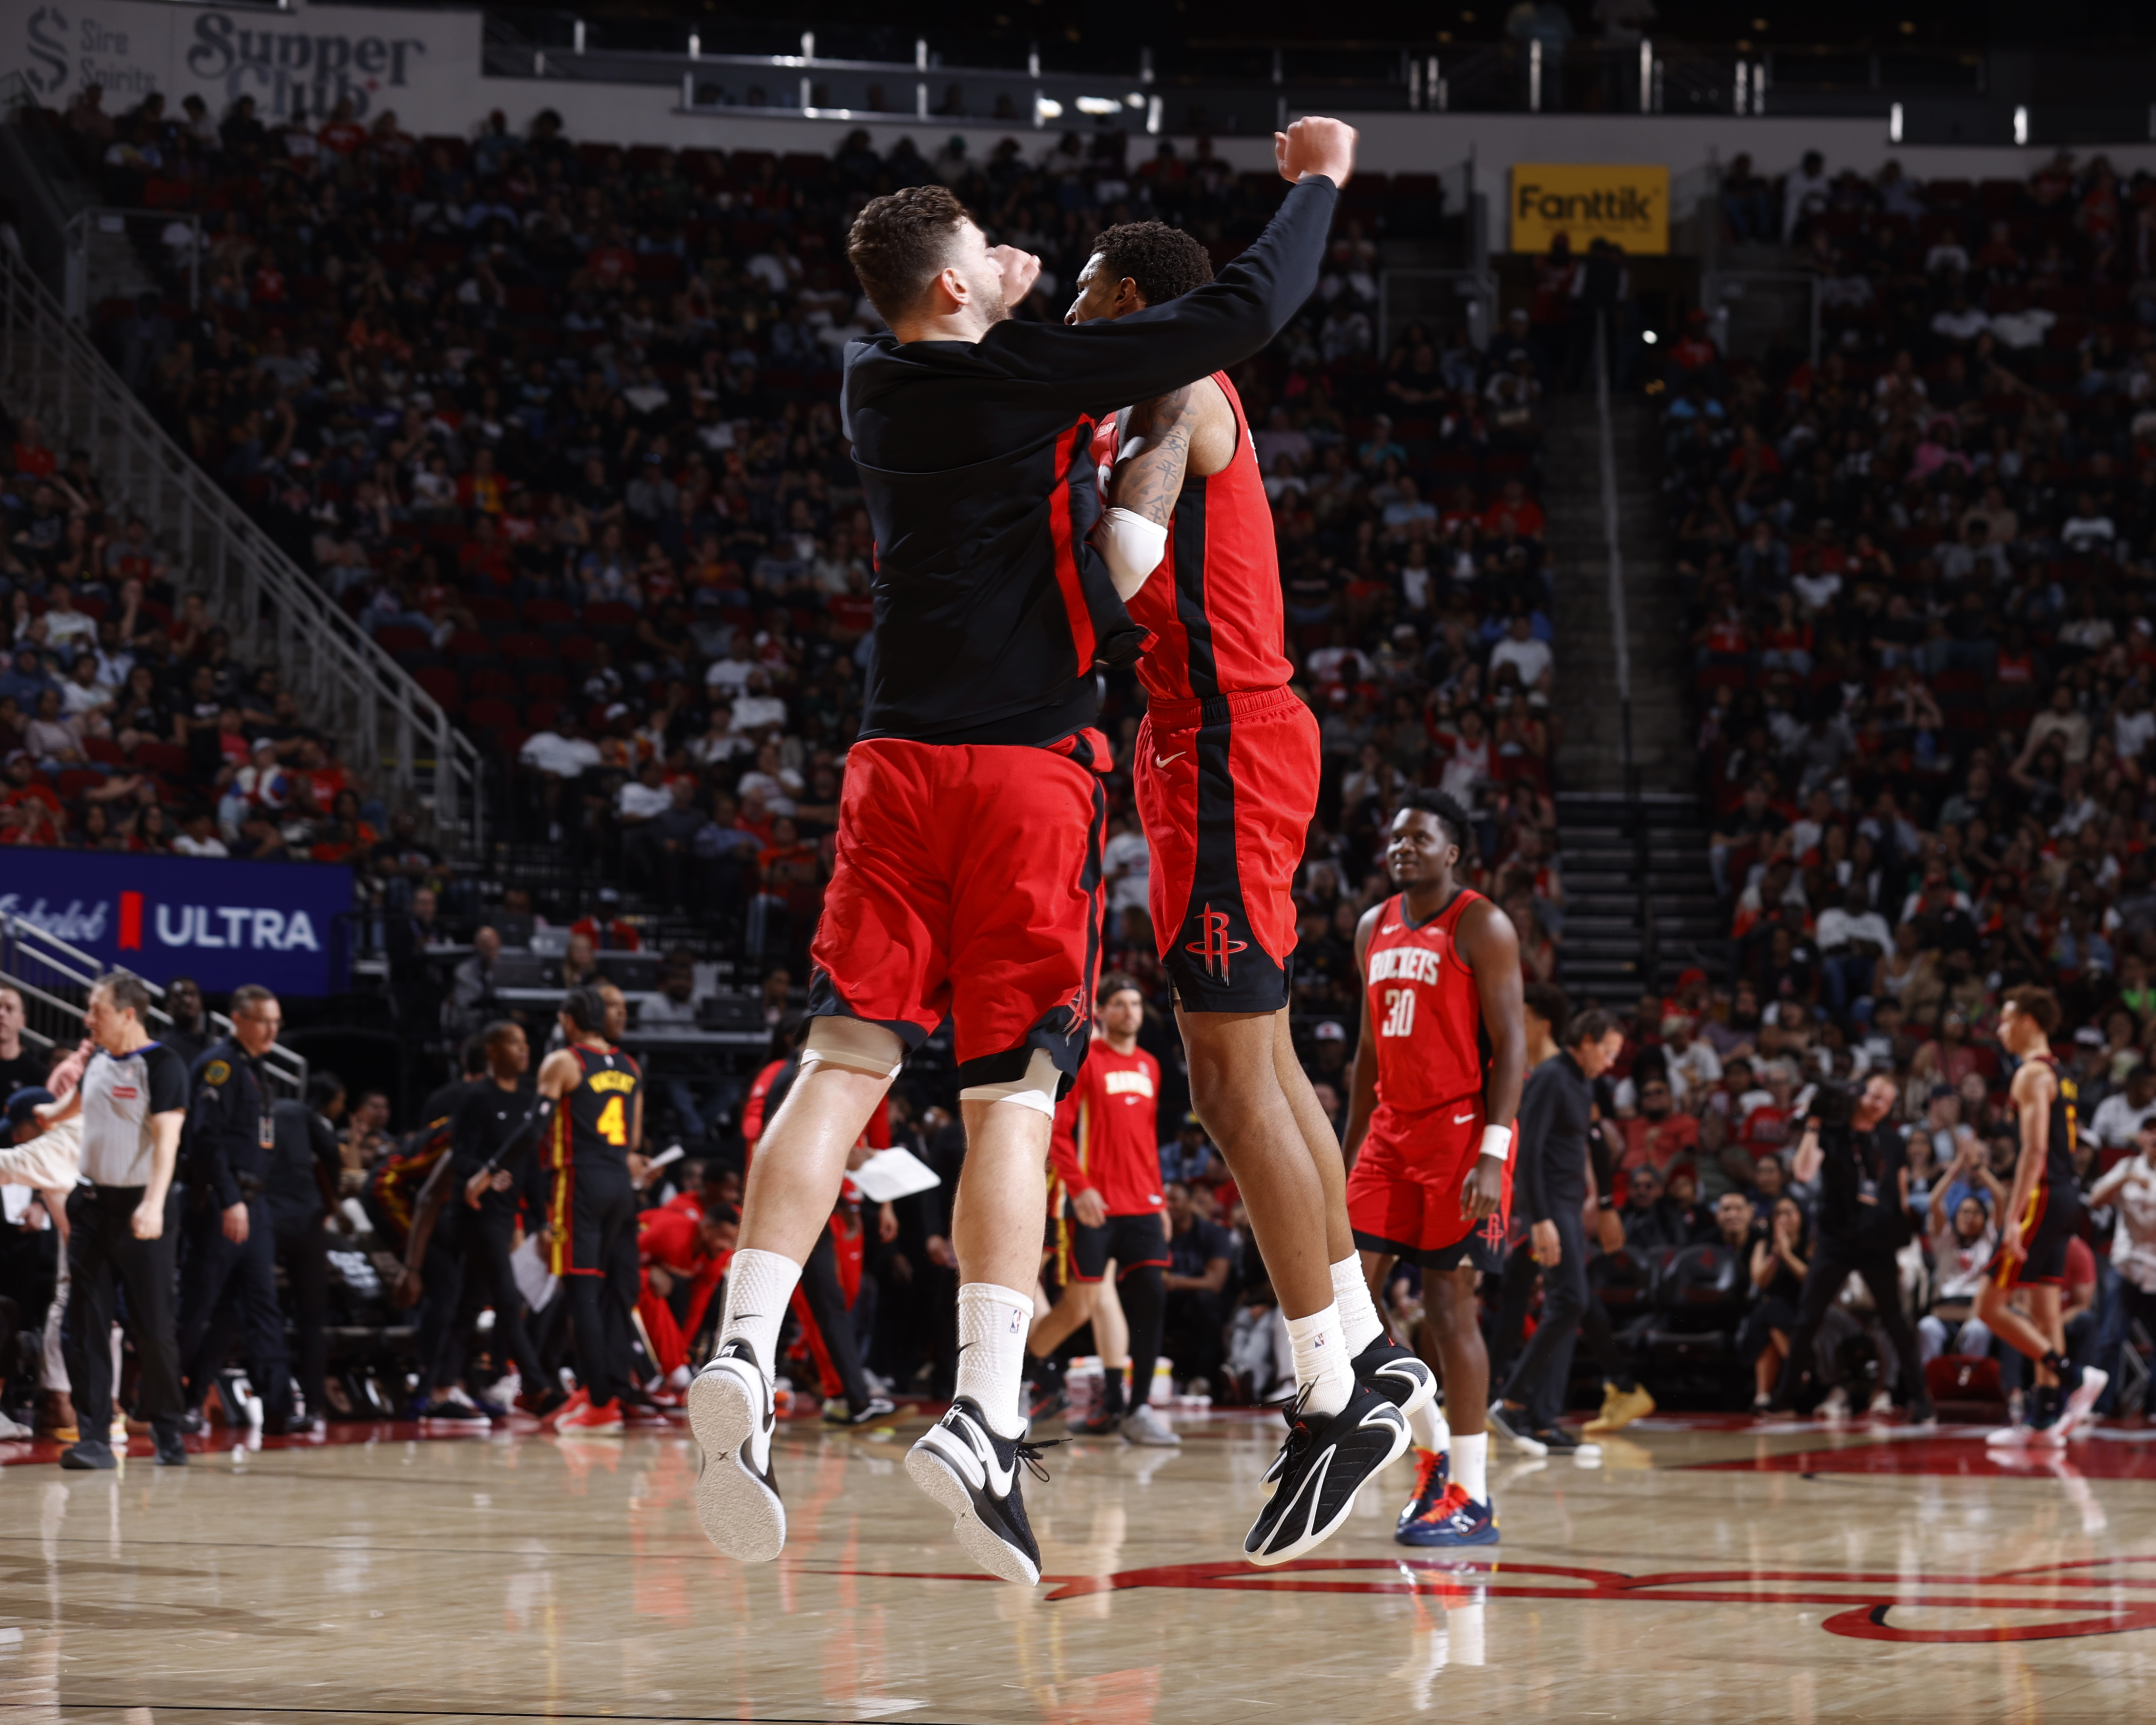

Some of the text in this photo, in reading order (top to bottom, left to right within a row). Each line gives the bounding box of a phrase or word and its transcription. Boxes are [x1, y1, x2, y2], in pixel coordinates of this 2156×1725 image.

[80, 18, 128, 56] Sire
[186, 12, 426, 86] Supper
[79, 56, 156, 94] Spirits
[1519, 185, 1651, 220] Fanttik
[156, 904, 320, 952] ULTRA
[1368, 946, 1441, 986] ROCKETS
[1382, 988, 1415, 1037] 30
[596, 1095, 628, 1146] 4
